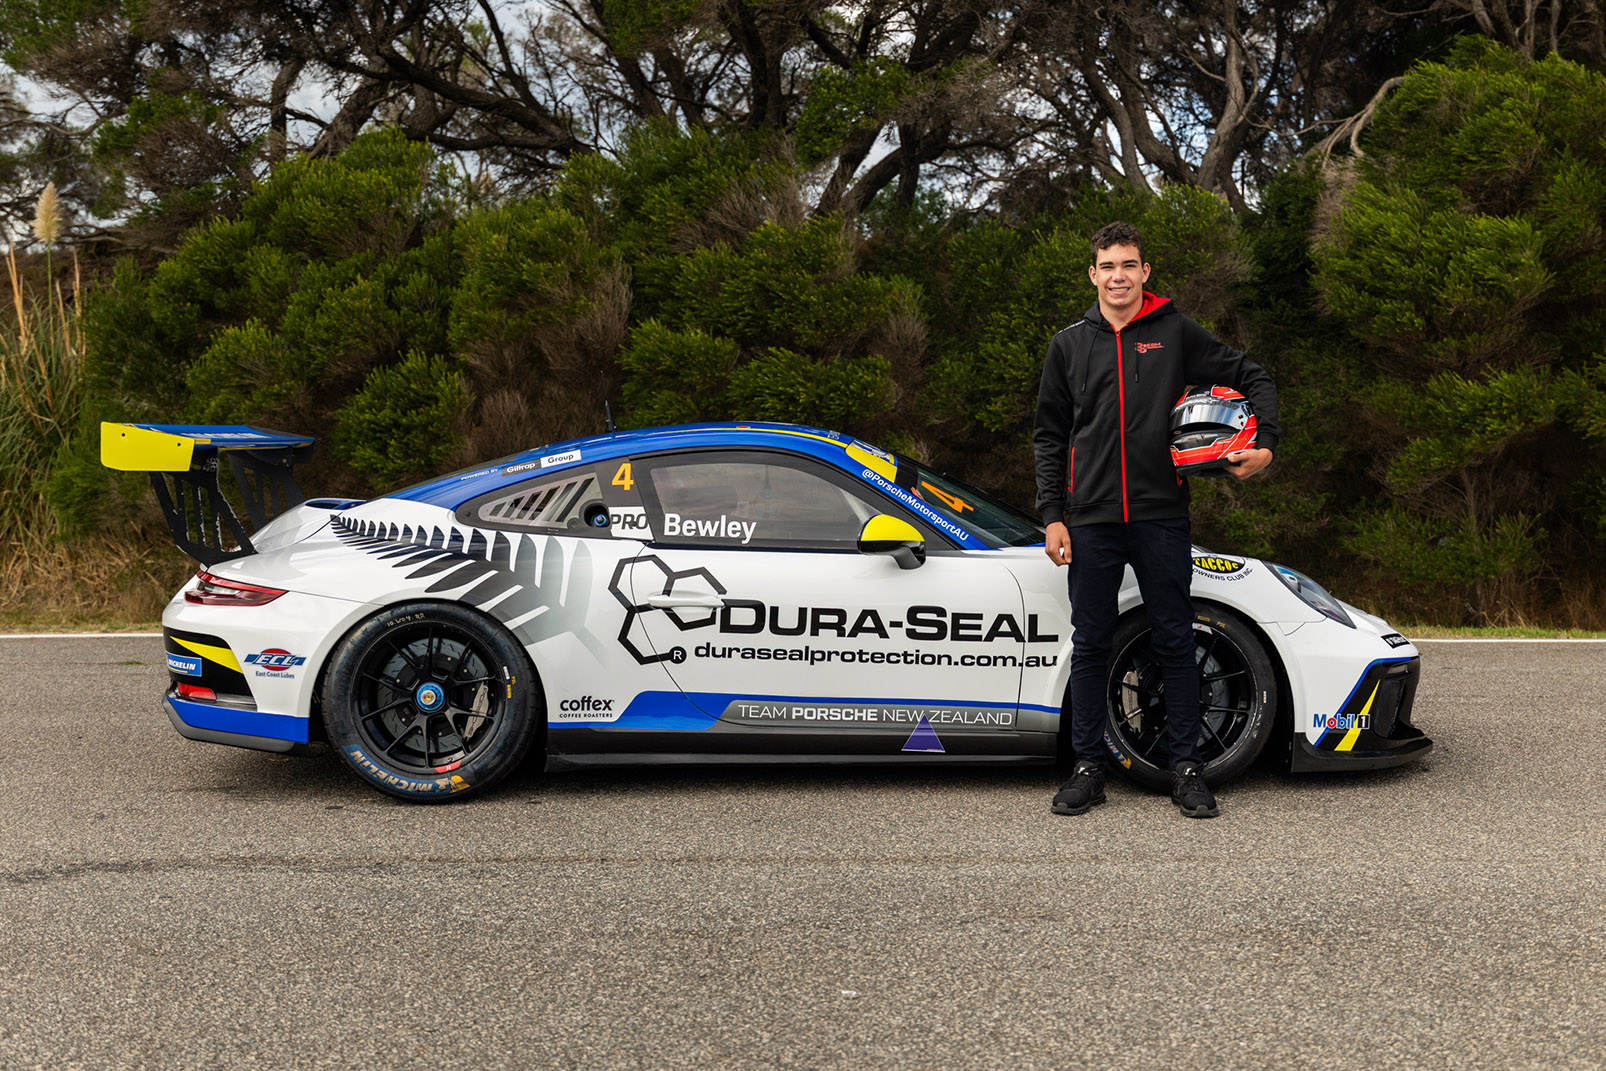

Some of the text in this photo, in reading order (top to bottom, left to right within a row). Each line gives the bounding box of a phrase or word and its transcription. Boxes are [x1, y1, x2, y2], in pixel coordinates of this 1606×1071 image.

[547, 453, 574, 464] Group
[611, 463, 634, 491] 4
[862, 468, 969, 542] @PorscheMotorsportAU
[611, 513, 649, 530] PRO
[664, 513, 757, 544] Bewley
[1192, 568, 1226, 581] OWNERS
[1226, 573, 1245, 581] CLUB
[694, 642, 1058, 668] durasealprotection.com.au
[559, 695, 613, 711] coffex
[738, 704, 1013, 726] TEAM PORSCHE NEW ZEALAND
[1312, 713, 1355, 729] Mobil
[350, 750, 433, 792] MICHELIN
